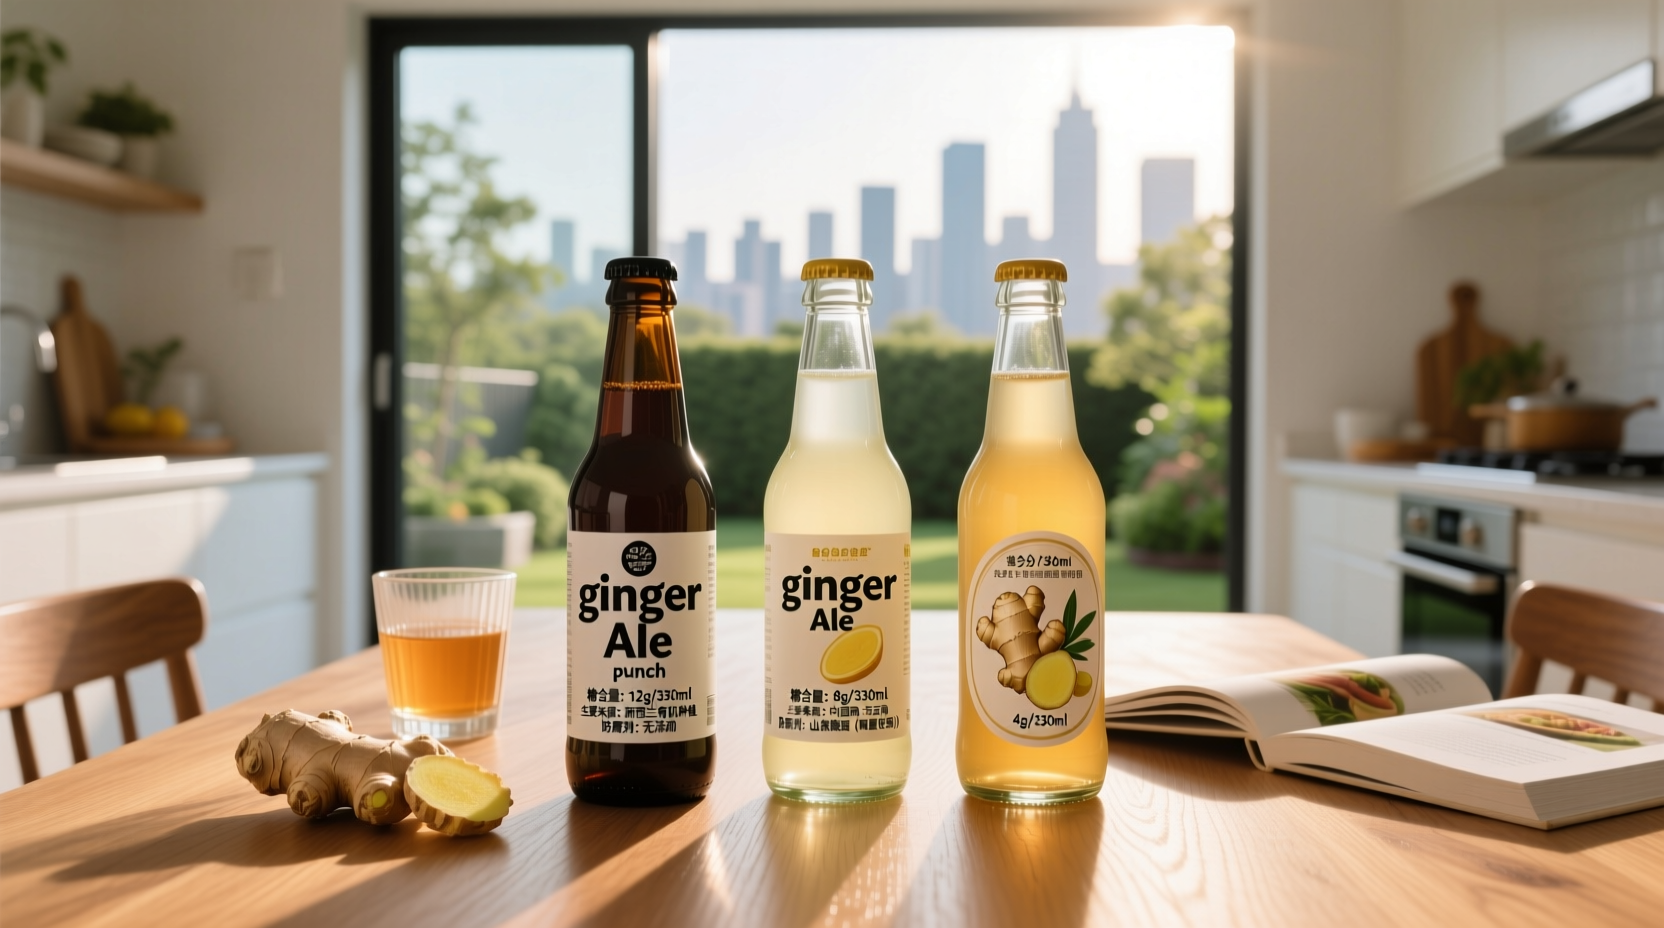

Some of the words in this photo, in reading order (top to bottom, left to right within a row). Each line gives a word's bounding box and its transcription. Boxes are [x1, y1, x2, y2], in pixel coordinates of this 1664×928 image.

[579, 573, 702, 624] ginger
[782, 565, 897, 613] ginger
[809, 607, 854, 631] Ale
[603, 622, 672, 658] Ale
[613, 662, 666, 682] punch
